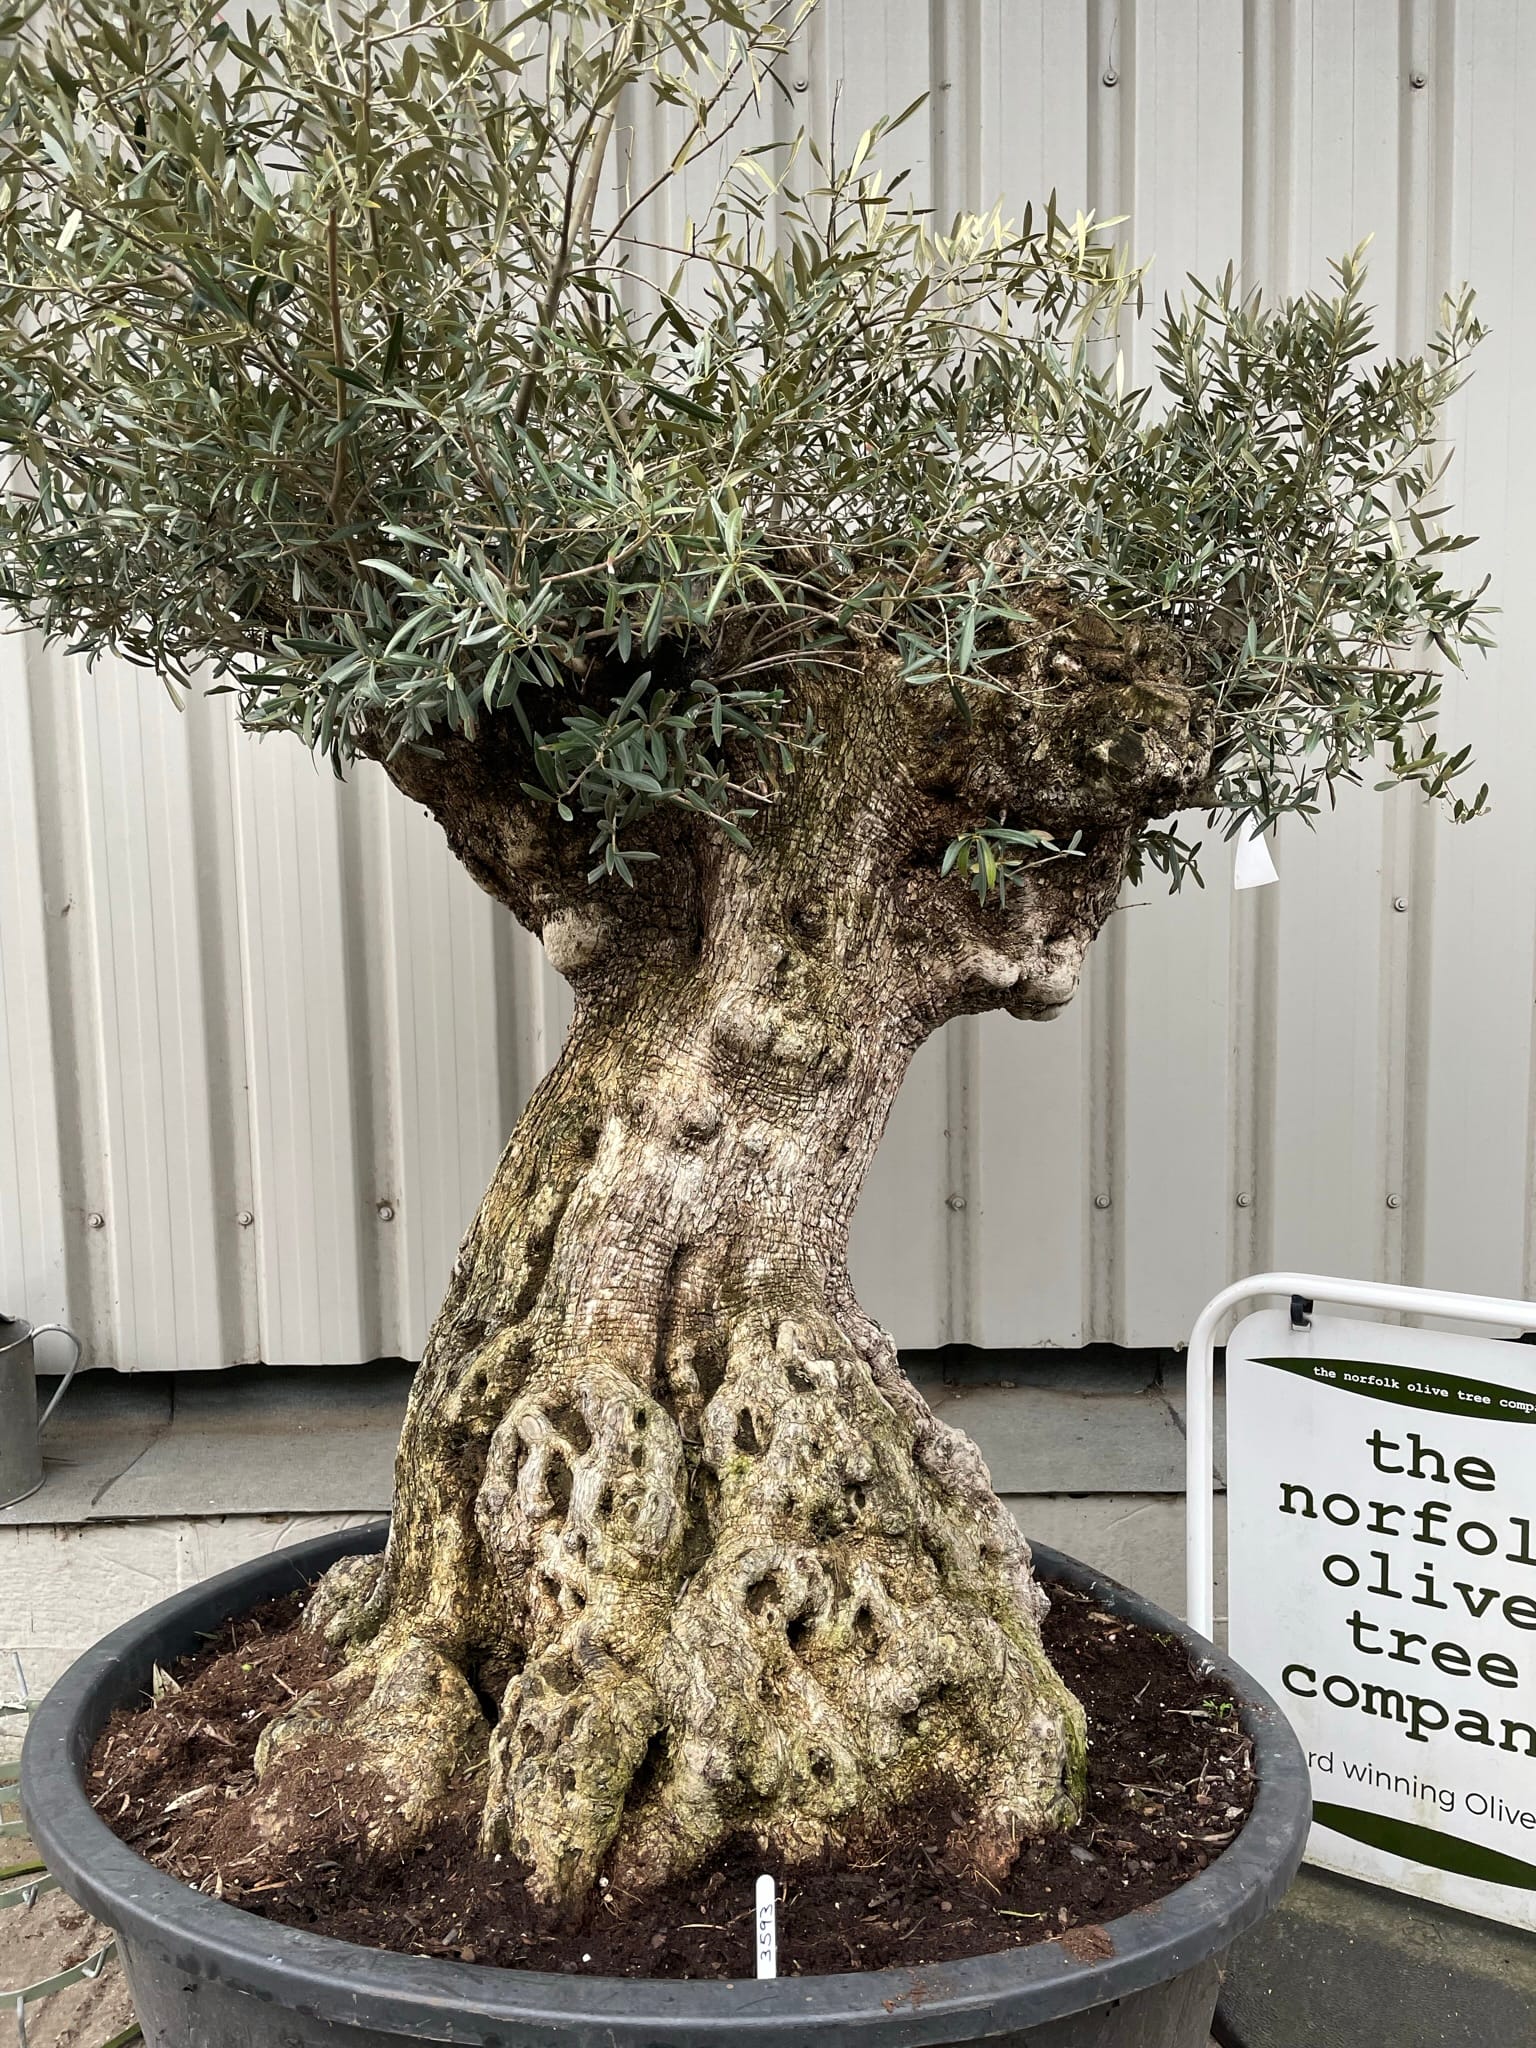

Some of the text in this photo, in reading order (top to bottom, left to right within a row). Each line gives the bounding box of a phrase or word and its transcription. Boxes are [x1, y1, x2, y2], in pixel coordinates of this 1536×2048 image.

[1313, 1365, 1536, 1414] the norfolk olive tree comp
[1366, 1429, 1496, 1492] the
[1322, 1550, 1536, 1631] olive
[1346, 1610, 1519, 1689] tree
[1342, 1760, 1455, 1813] winning
[1465, 1792, 1536, 1830] Olive
[759, 1903, 773, 1963] 3593
